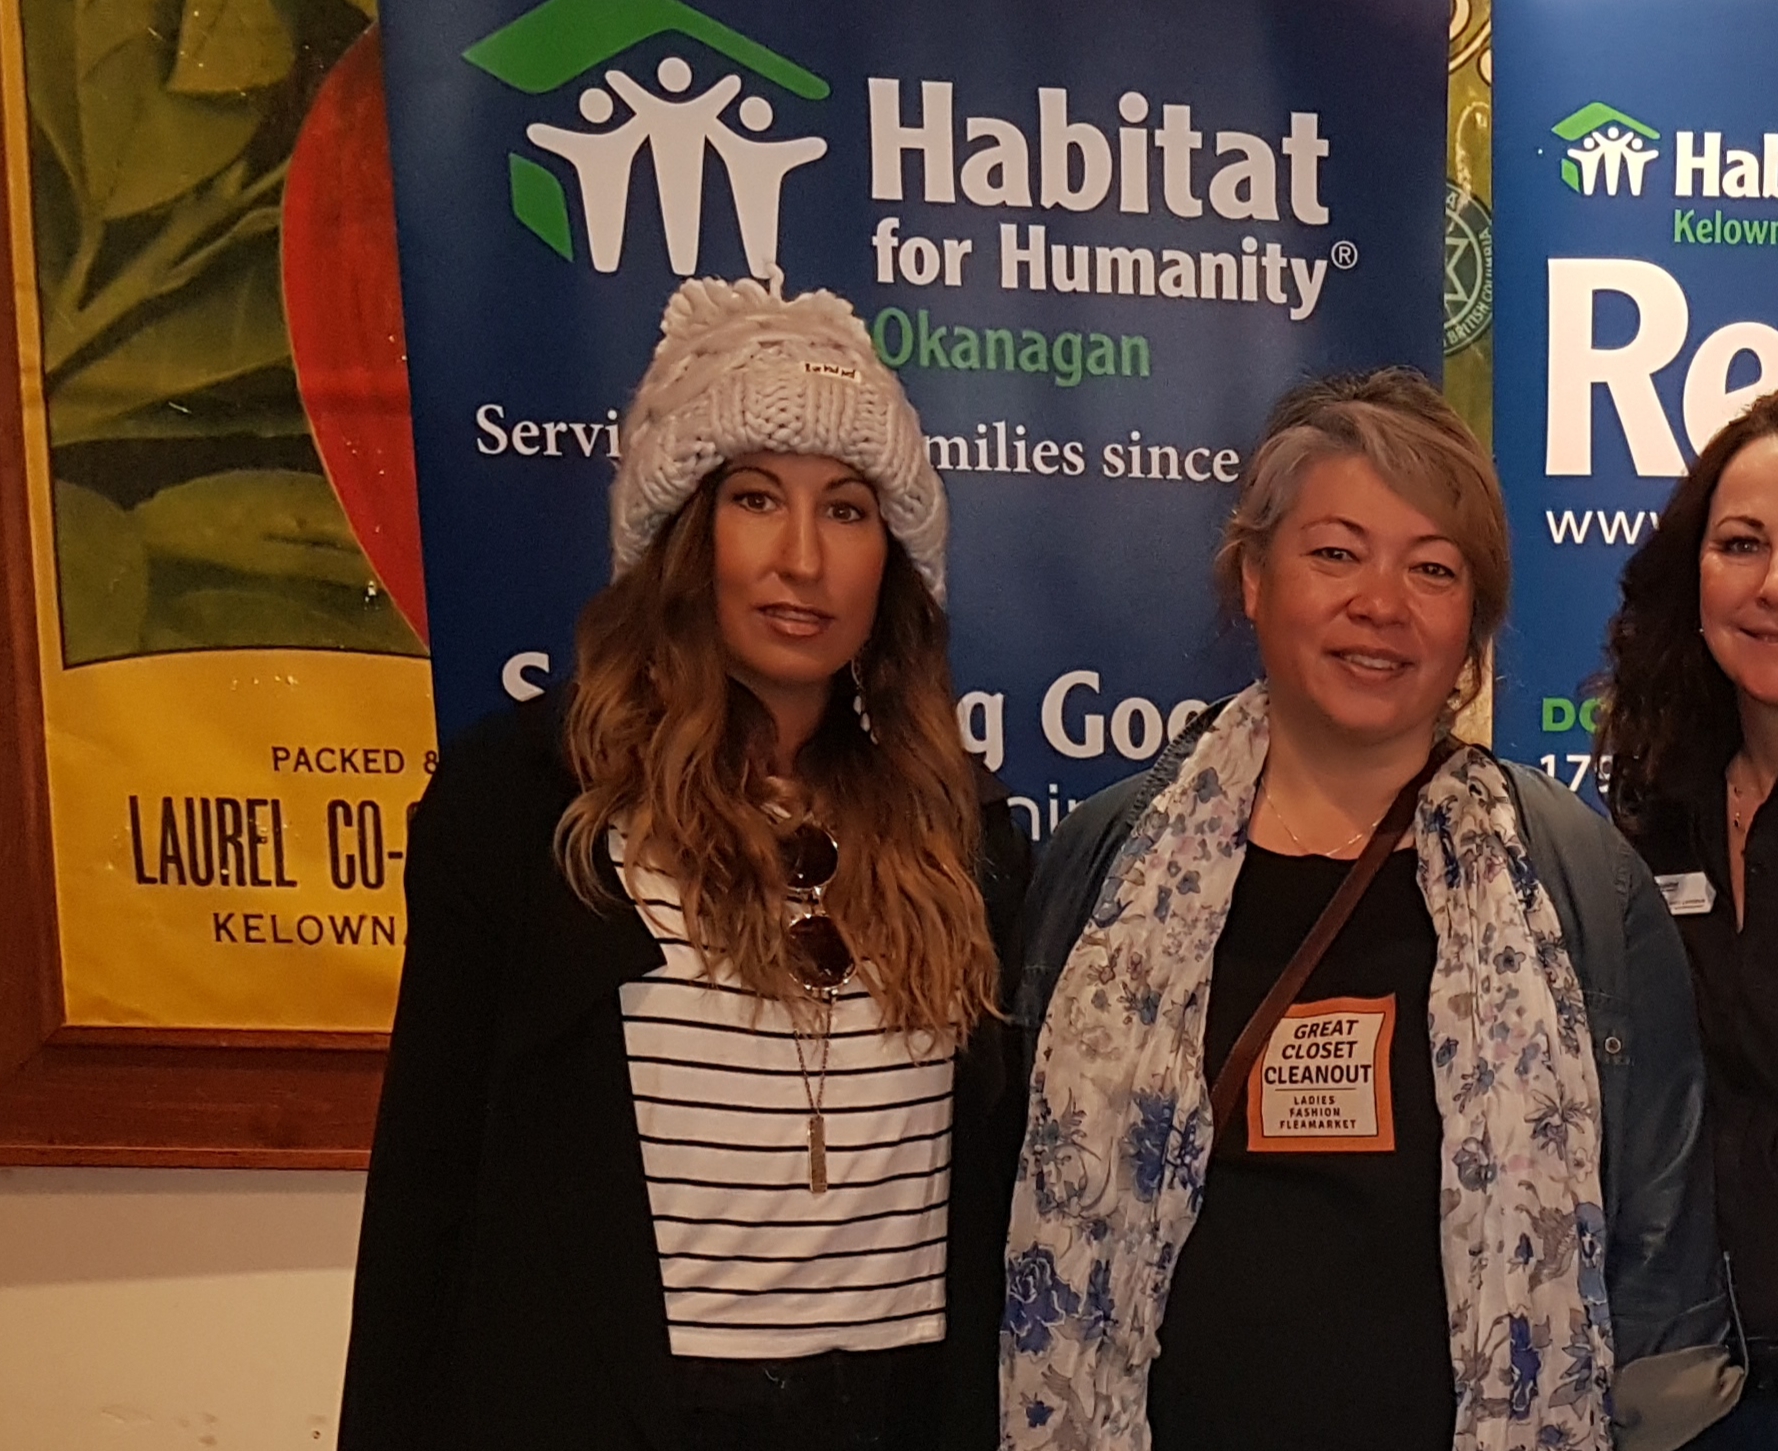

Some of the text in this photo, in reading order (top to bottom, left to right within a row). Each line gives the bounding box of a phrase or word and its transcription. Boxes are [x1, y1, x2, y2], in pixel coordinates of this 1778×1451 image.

[868, 79, 1330, 225] Habitat
[872, 218, 971, 285] for
[873, 308, 1150, 387] Okanagan
[475, 404, 1240, 482] Servi milies since
[271, 746, 405, 774] PACKED
[129, 795, 297, 887] LAUREL
[213, 912, 408, 946] KELOWN
[1293, 1020, 1359, 1039] GREAT
[1281, 1041, 1358, 1060] CLOSET
[1264, 1065, 1372, 1085] CLEANOUT
[1289, 1108, 1340, 1118] FASHION
[1294, 1096, 1336, 1105] LADIES
[1280, 1120, 1356, 1129] FLEAMARKET
